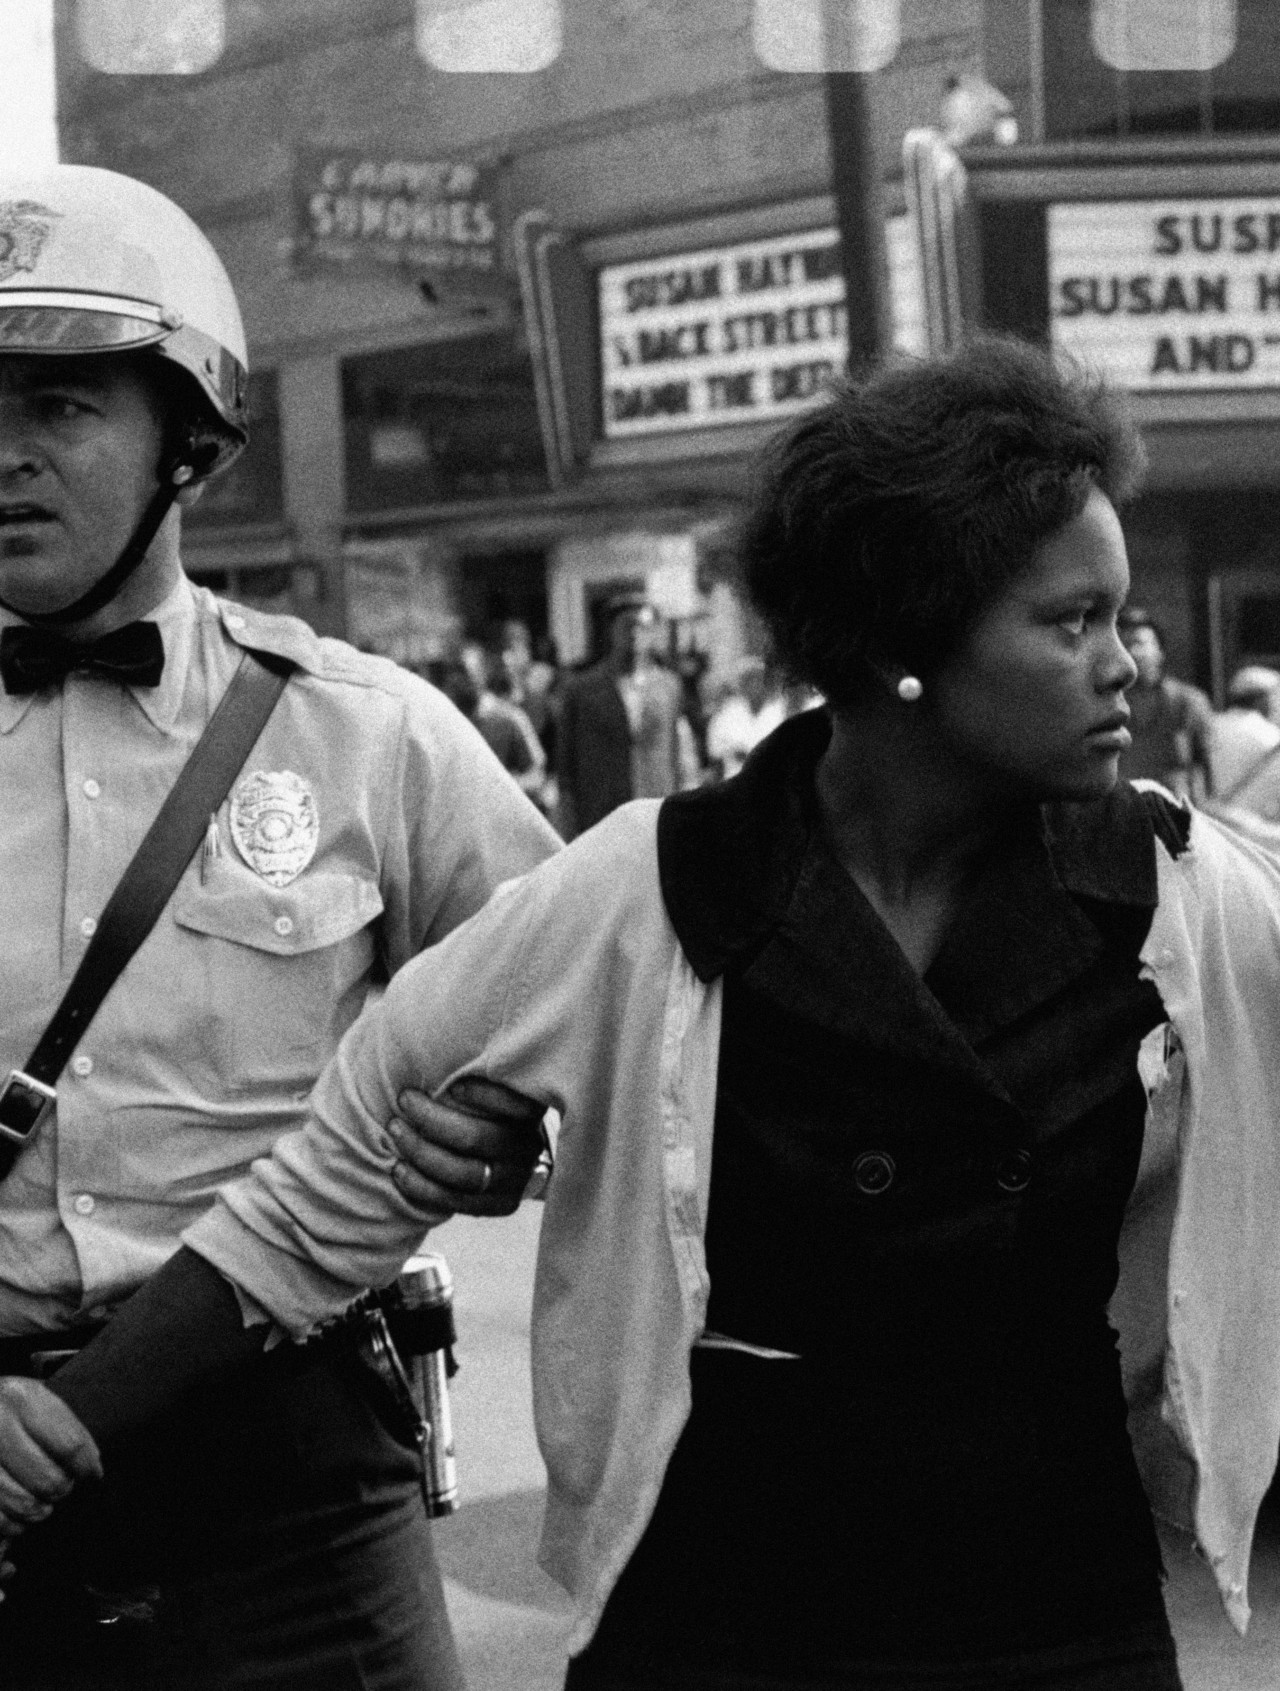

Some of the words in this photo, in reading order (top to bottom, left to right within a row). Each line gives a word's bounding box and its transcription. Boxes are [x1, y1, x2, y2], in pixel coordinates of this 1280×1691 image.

[626, 262, 721, 314] SUSAN
[1059, 270, 1228, 318] SUSAN
[638, 318, 710, 363] BACK
[724, 301, 850, 354] STREET
[1149, 334, 1256, 376] AND
[611, 379, 691, 421] DAMN
[706, 370, 755, 411] THE
